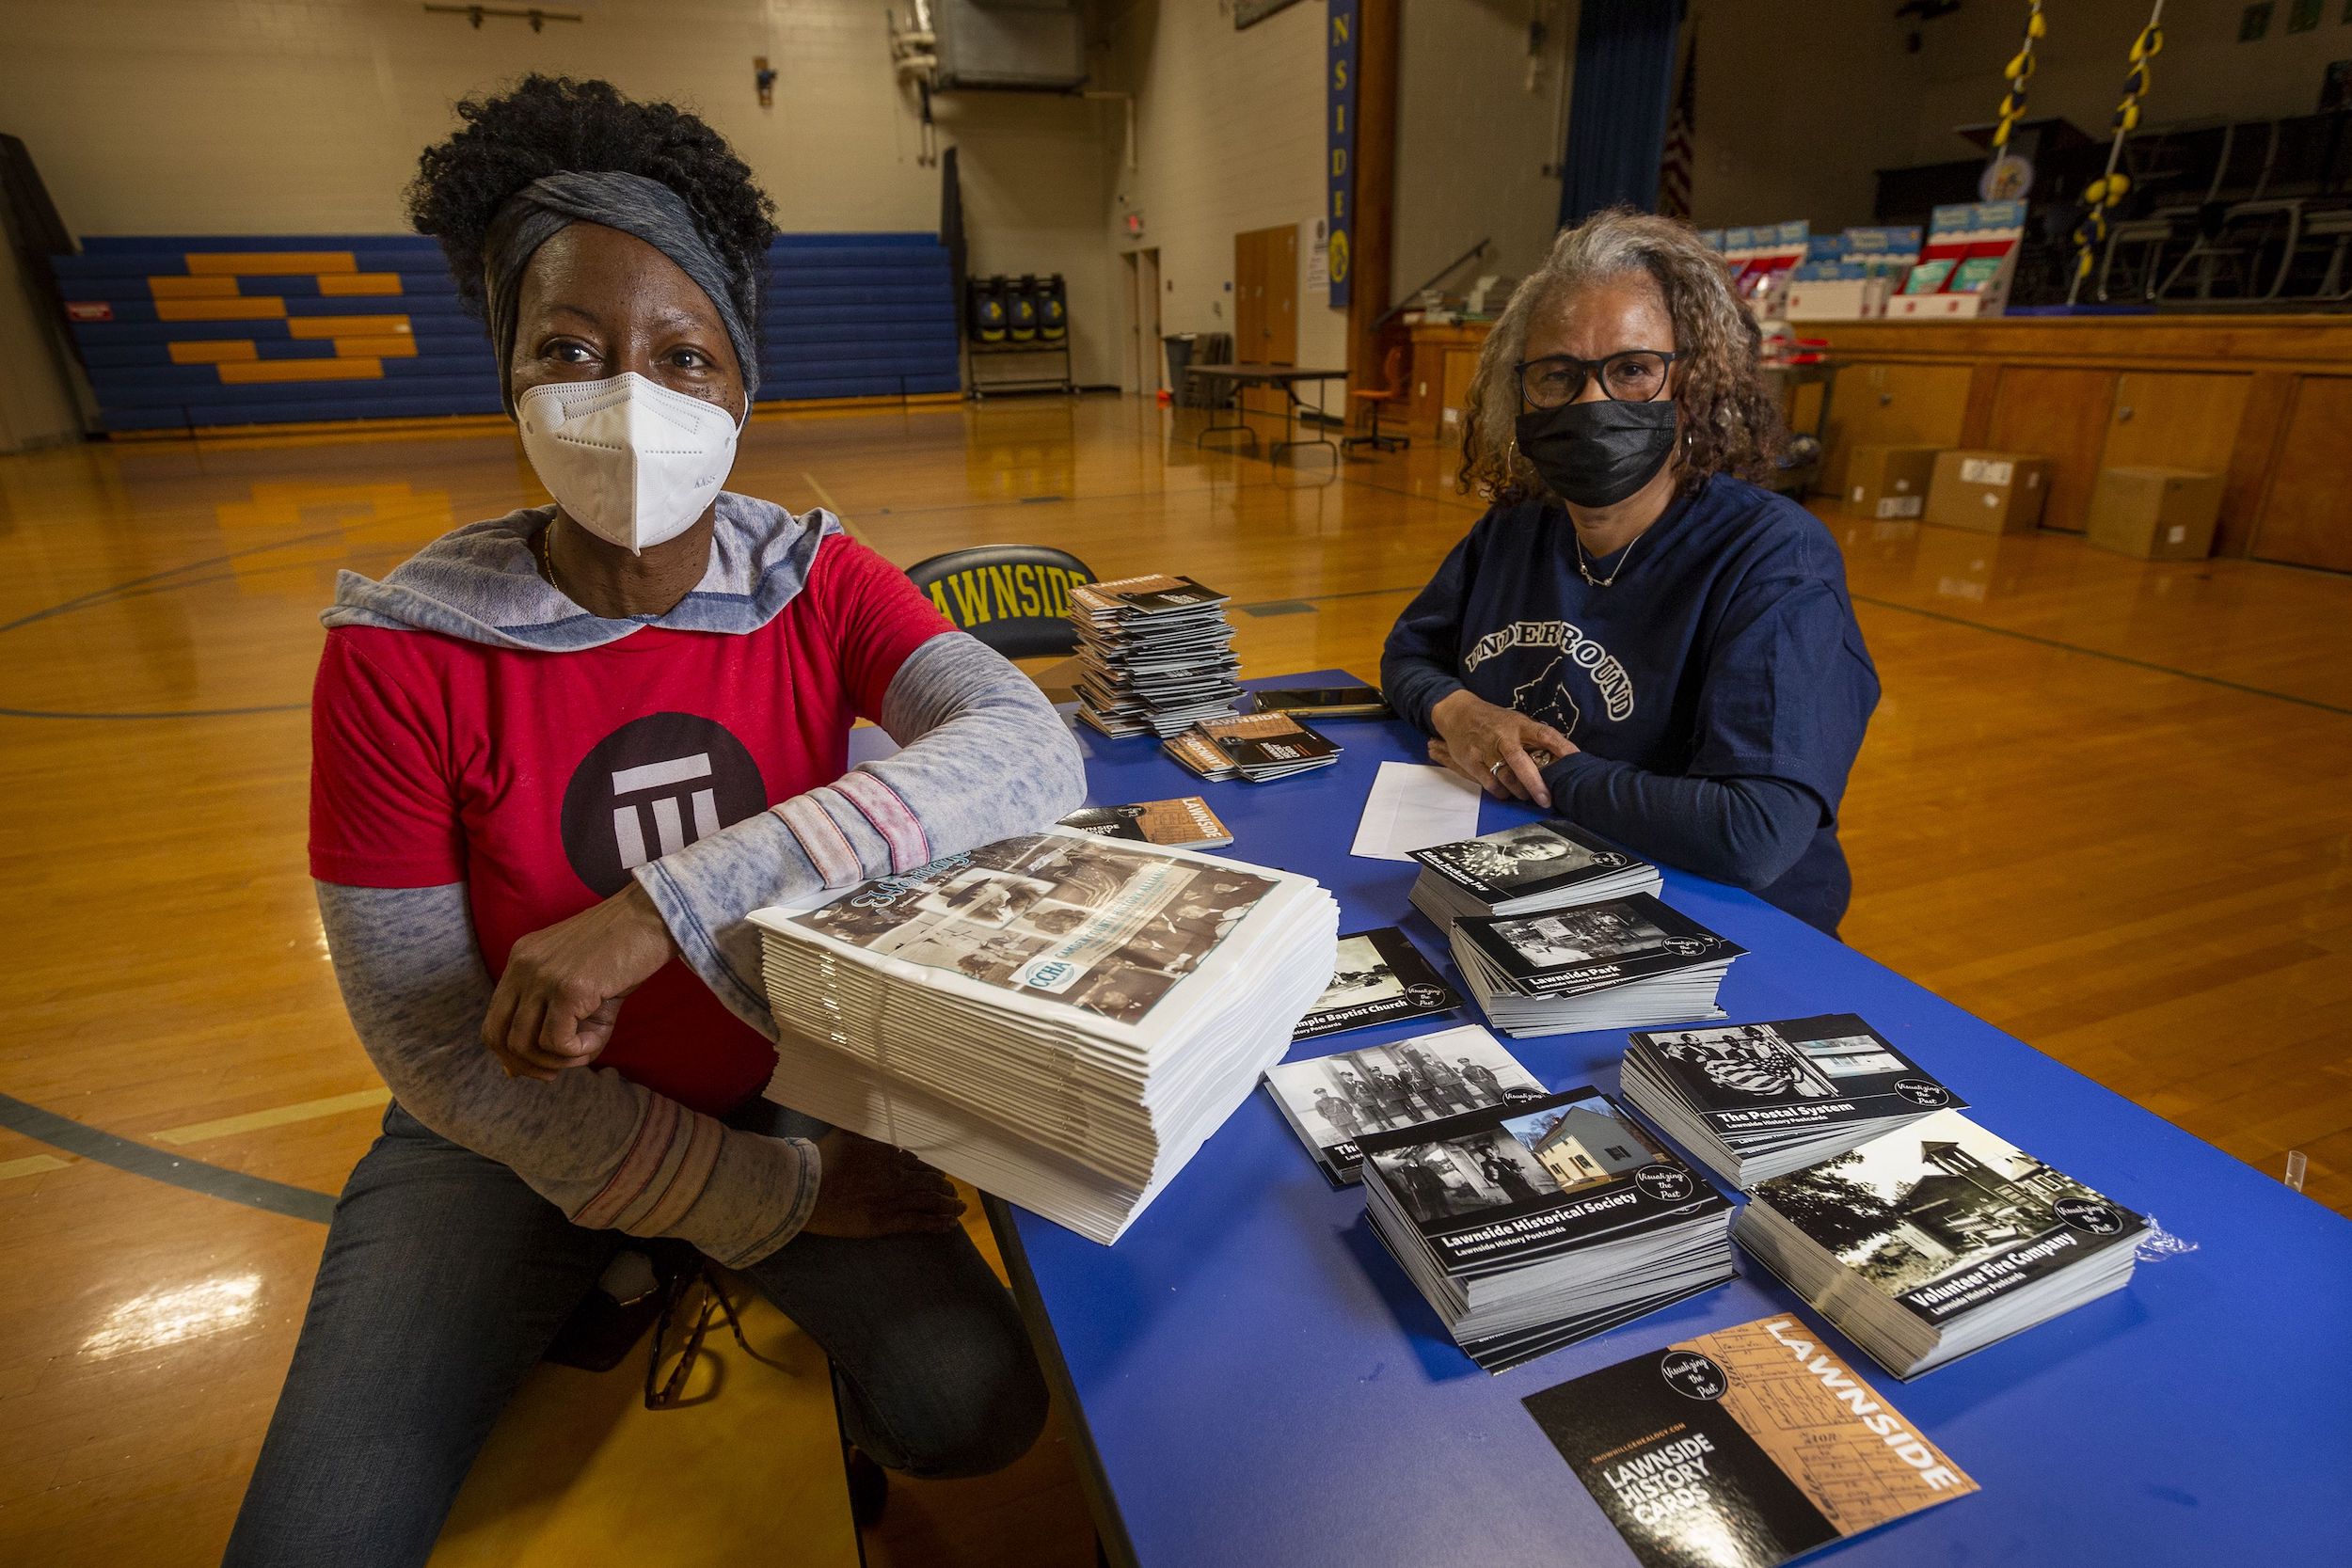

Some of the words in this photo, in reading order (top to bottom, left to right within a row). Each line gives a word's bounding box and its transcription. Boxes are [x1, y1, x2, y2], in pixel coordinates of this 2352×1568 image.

[1332, 13, 1349, 217] NSIDE
[1200, 712, 1283, 727] LAWNSIDE
[1182, 798, 1222, 838] LAWNSIDE
[1028, 960, 1073, 988] CCHA
[1529, 971, 1590, 985] Lawnside
[1588, 965, 1621, 976] Park
[1295, 1017, 1327, 1028] mple
[1326, 1006, 1369, 1021] Baptist
[1368, 999, 1408, 1014] Church
[1310, 1022, 1342, 1032] Postcards
[1897, 1083, 1940, 1094] Visualizing
[1717, 1112, 1749, 1122] The
[1747, 1105, 1799, 1120] Postal
[1799, 1102, 1856, 1117] System
[1789, 1115, 1828, 1123] Postcards
[1638, 1172, 1683, 1182] Visualizing
[1661, 1191, 1681, 1199] Past
[1441, 1223, 1513, 1248] Lawnside
[1515, 1205, 1586, 1232] Historical
[1586, 1192, 1639, 1214] Society
[1454, 1241, 1496, 1257] Lawnside
[1495, 1234, 1526, 1248] History
[1524, 1225, 1566, 1241] Postcards
[1909, 1271, 1988, 1307] Volunteer
[1978, 1259, 2015, 1278] Fire
[2009, 1230, 2078, 1266] Company
[1663, 1357, 1710, 1380] Visualizing
[1687, 1373, 1705, 1385] the
[1697, 1383, 1719, 1399] Past
[1764, 1320, 1962, 1492] LAWNSIDE
[1602, 1432, 1716, 1490] LAWNSIDE
[1616, 1456, 1710, 1510] HISTORY
[1632, 1482, 1711, 1527] CARDS
